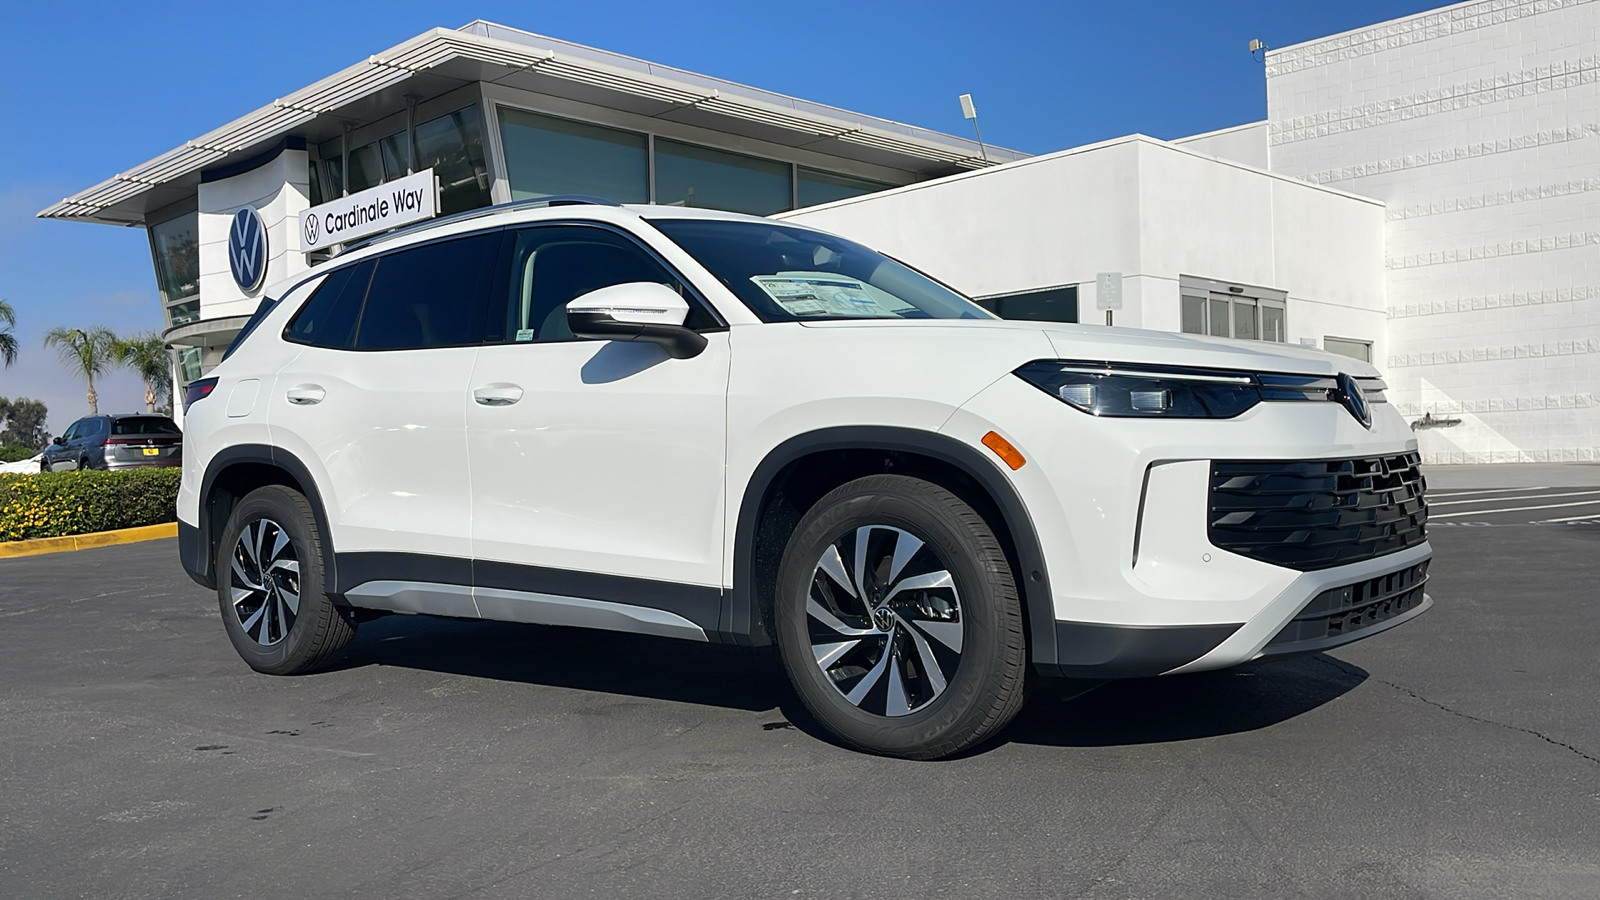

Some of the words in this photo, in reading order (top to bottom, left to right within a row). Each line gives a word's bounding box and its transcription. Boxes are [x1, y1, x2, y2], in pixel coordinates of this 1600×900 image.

[229, 206, 263, 286] VW
[305, 214, 319, 243] VW
[325, 197, 389, 234] Cardinale
[392, 188, 424, 214] Way
